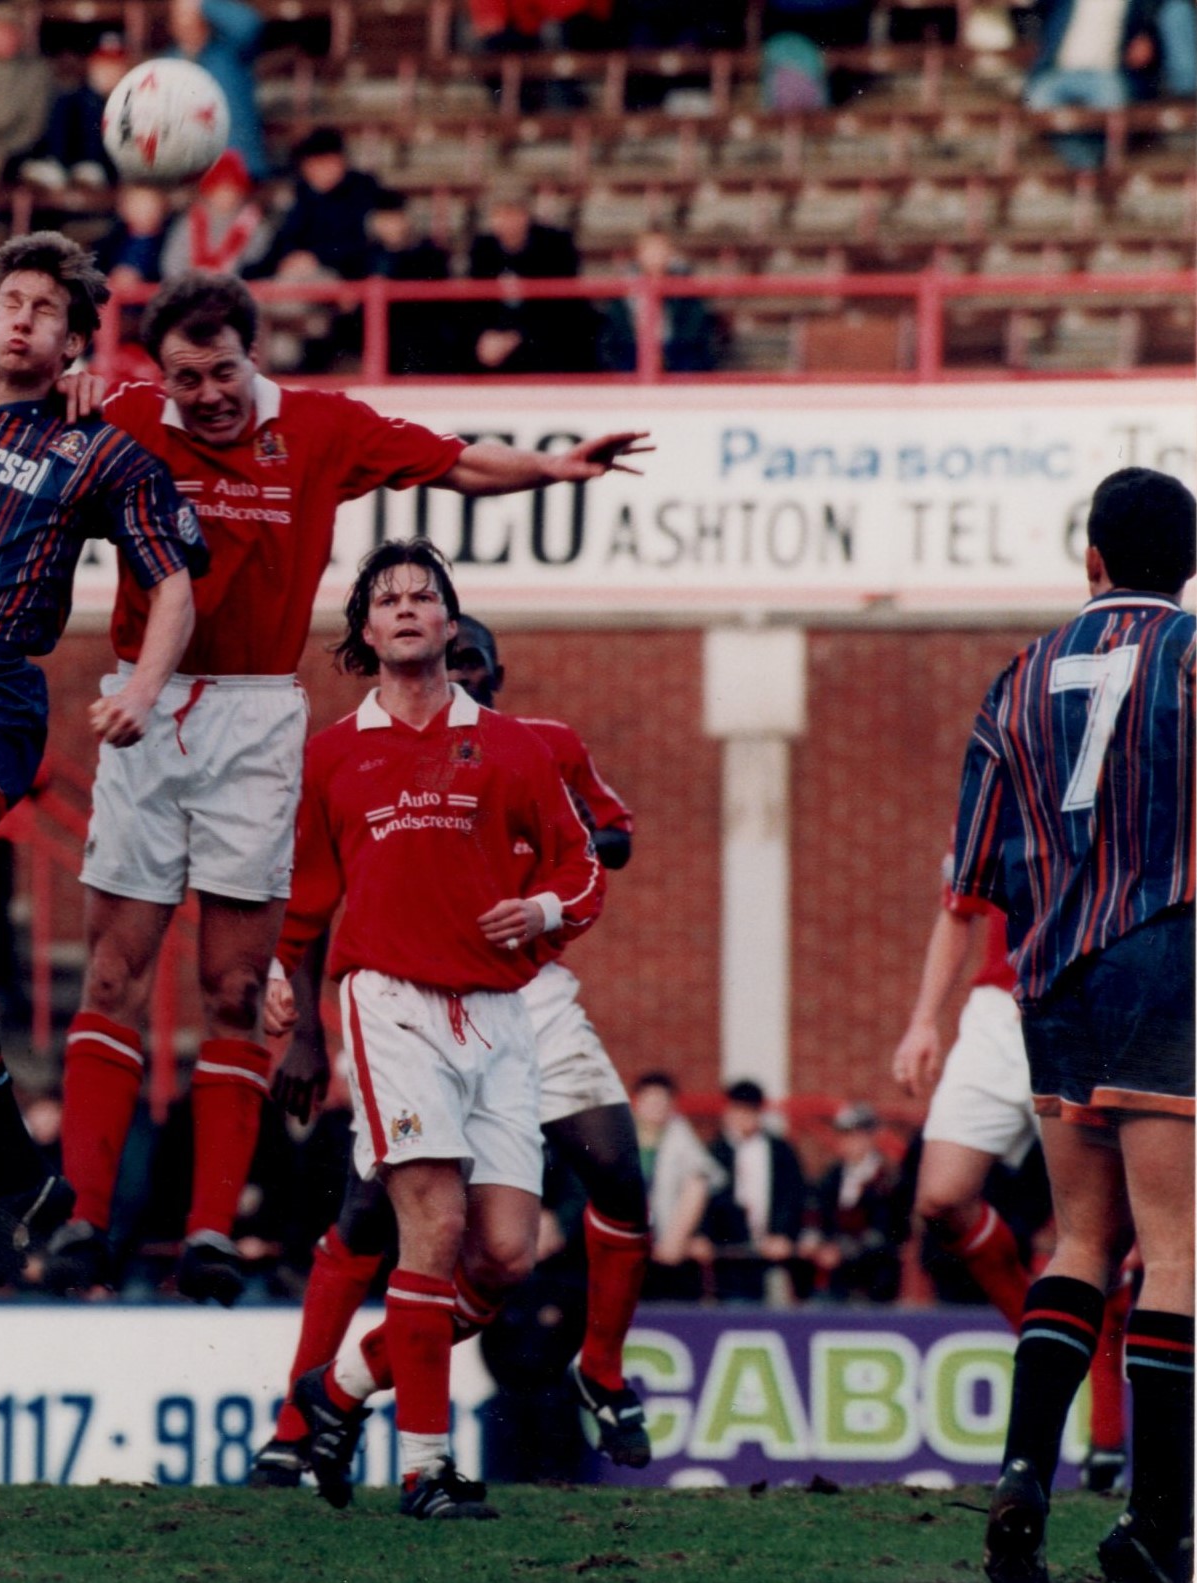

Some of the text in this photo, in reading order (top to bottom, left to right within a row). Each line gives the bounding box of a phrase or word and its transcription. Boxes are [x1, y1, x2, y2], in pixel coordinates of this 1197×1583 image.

[720, 427, 1072, 482] Panasonic
[213, 478, 259, 497] Auto
[606, 500, 857, 568] ASHTON
[906, 500, 1010, 566] TEL
[1049, 643, 1140, 812] 7
[397, 790, 441, 808] Auto
[580, 1329, 1094, 1462] CABO
